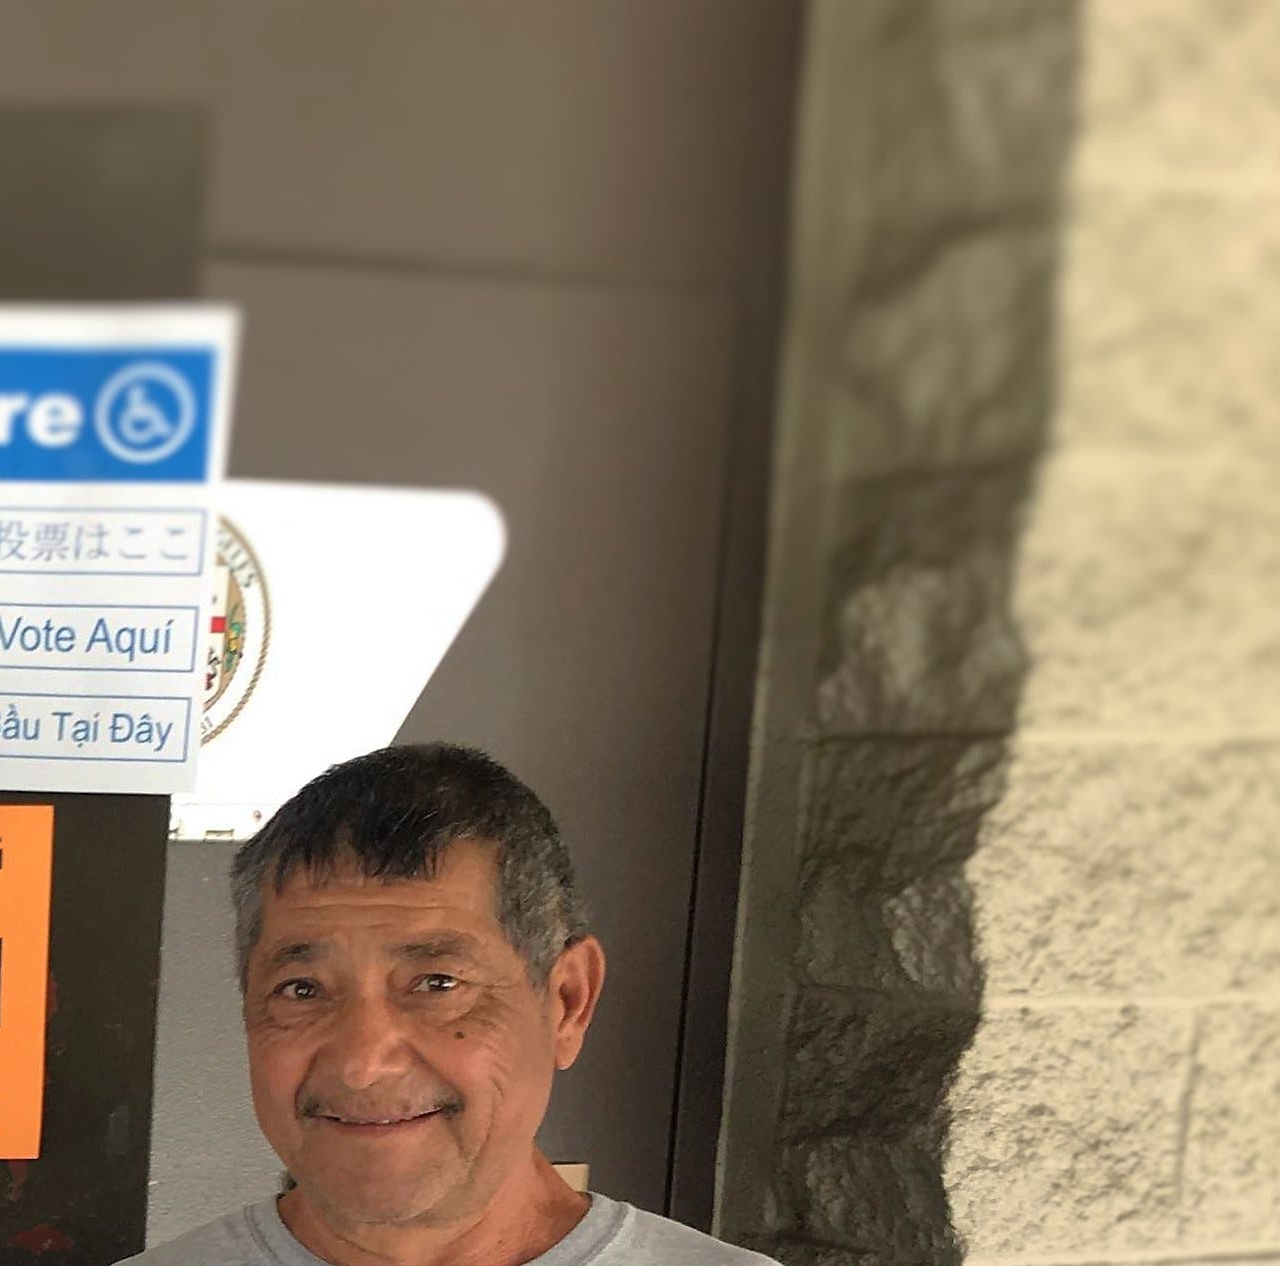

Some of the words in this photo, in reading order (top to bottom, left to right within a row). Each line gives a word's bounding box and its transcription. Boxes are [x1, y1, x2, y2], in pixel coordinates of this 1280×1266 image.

[85, 618, 175, 662] Aquí
[51, 711, 101, 751] Tại
[109, 712, 173, 751] Đây
